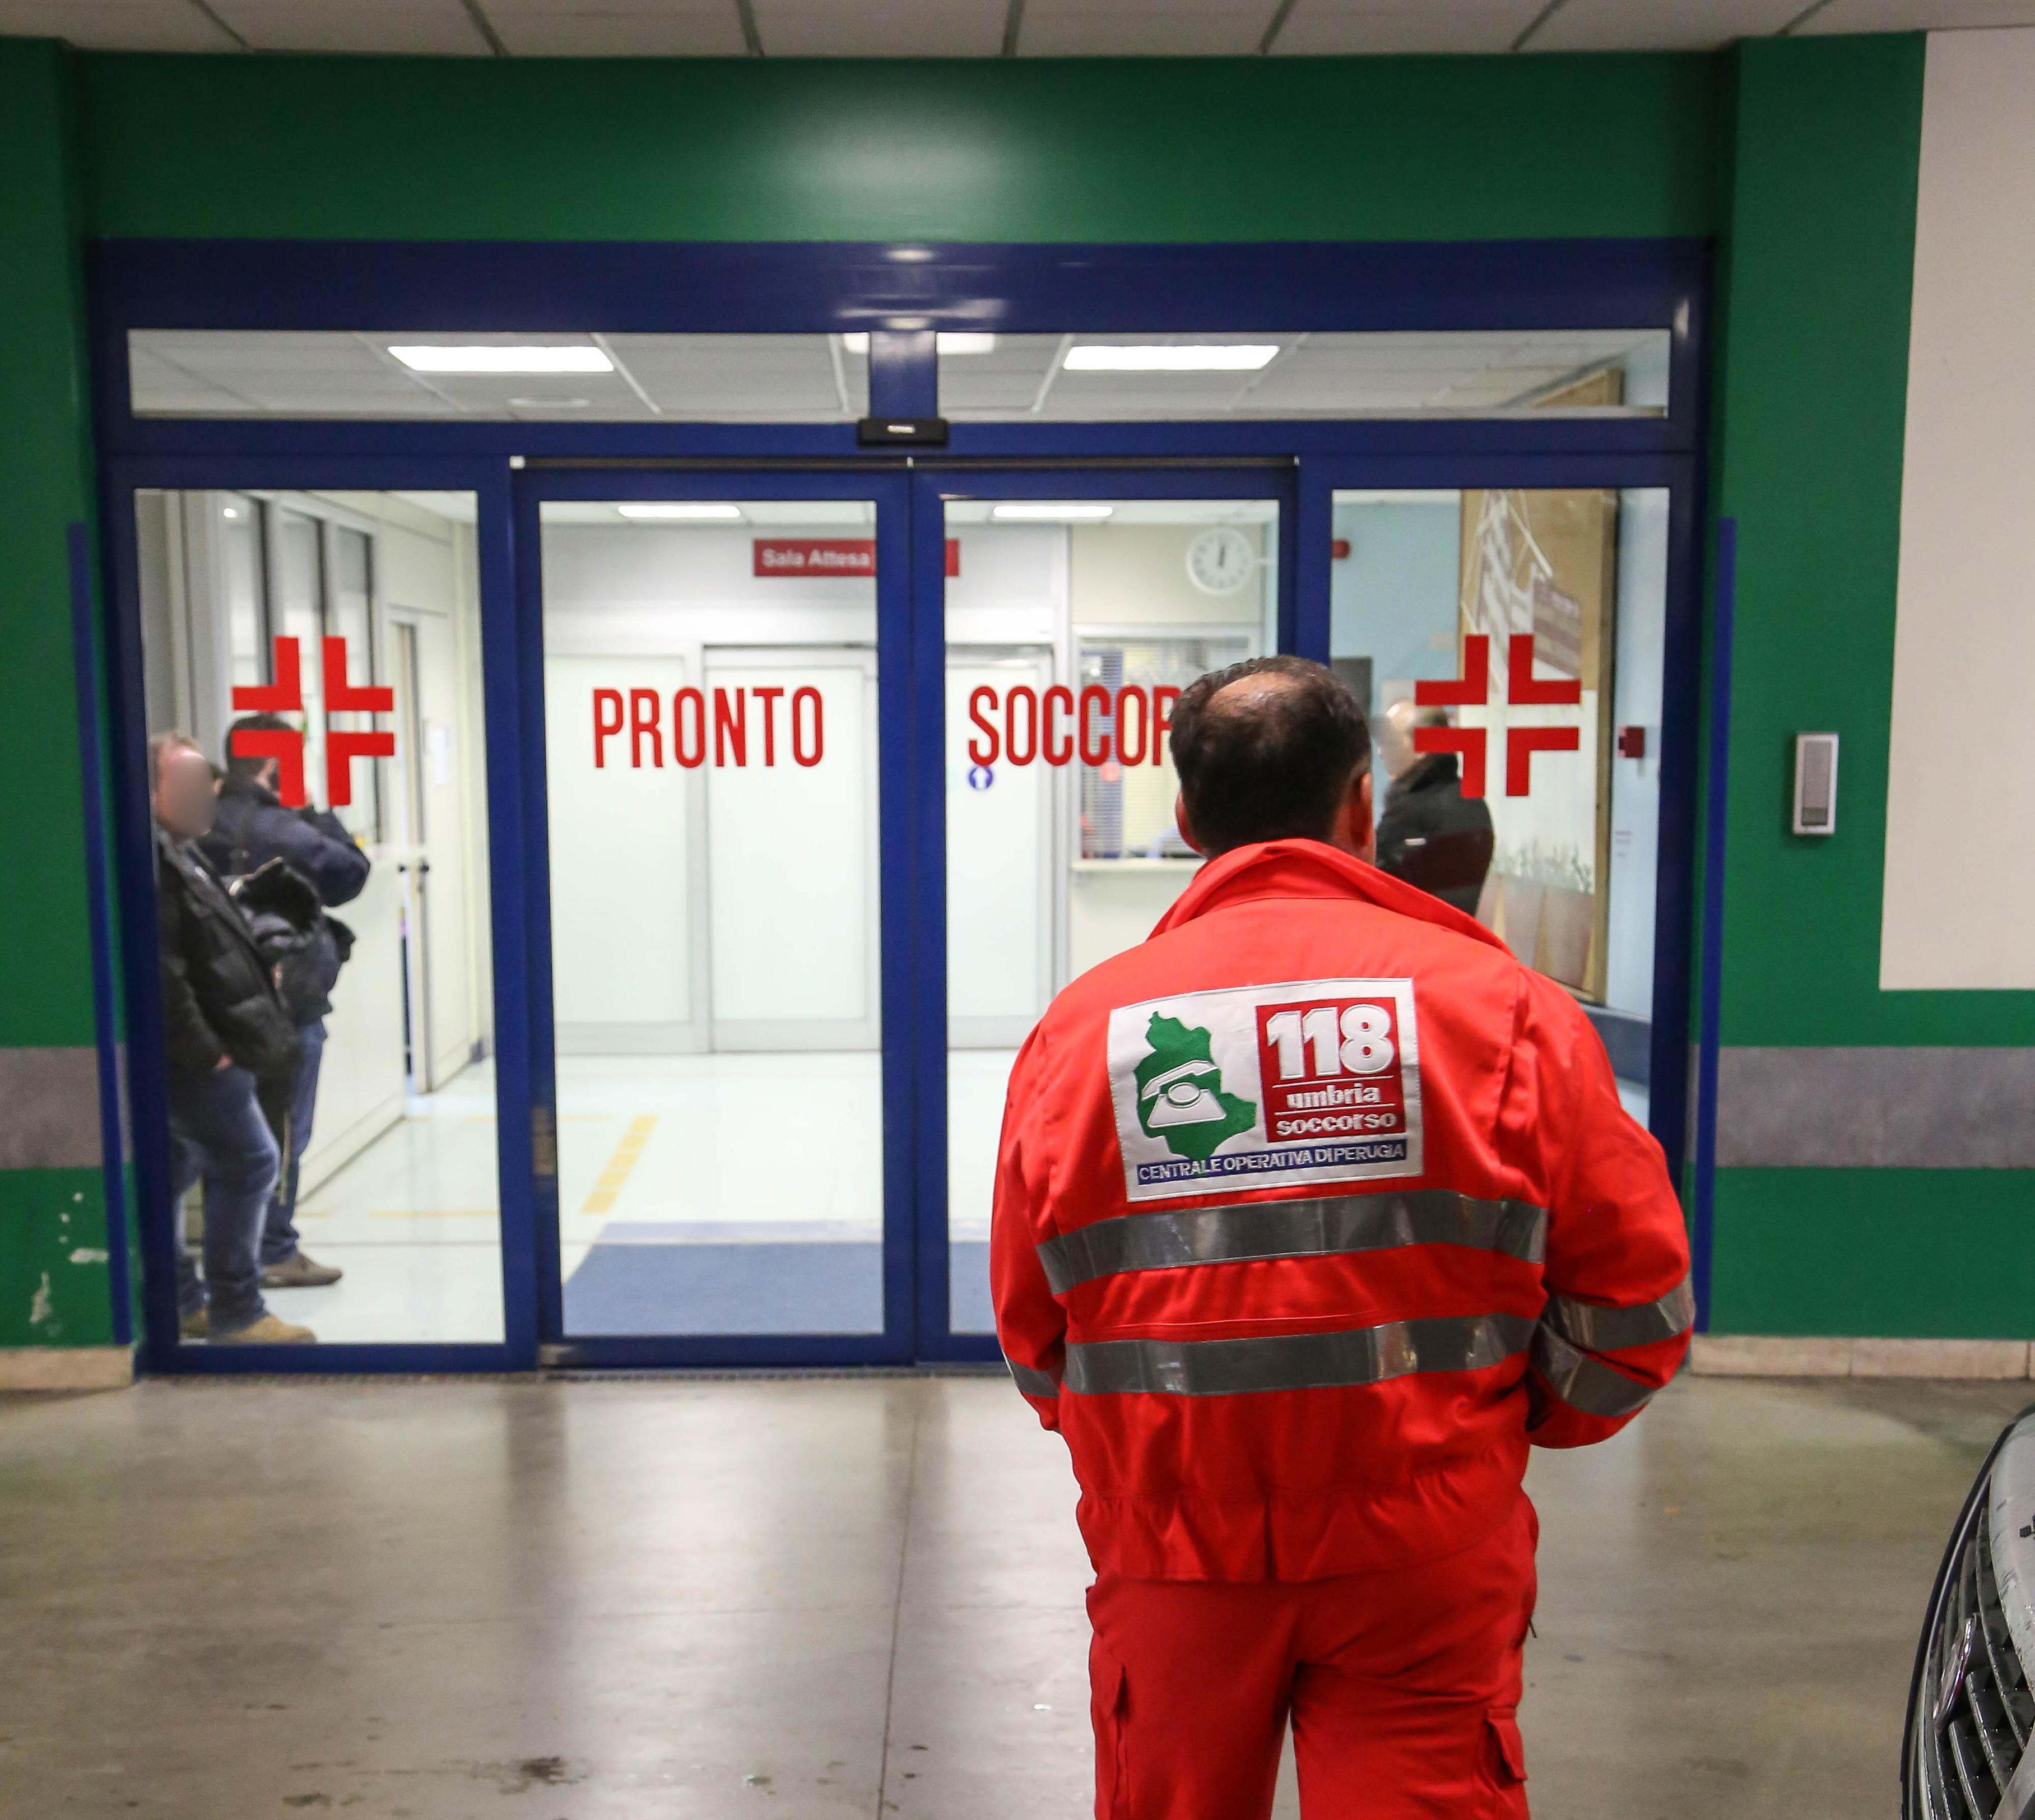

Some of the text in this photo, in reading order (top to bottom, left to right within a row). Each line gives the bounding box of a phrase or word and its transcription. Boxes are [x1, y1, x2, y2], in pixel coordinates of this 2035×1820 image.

[761, 548, 870, 568] Sala Attesa
[593, 686, 823, 768] PRONTO
[1266, 1004, 1395, 1080] 118
[1286, 1083, 1381, 1109] umbria
[1276, 1113, 1397, 1136] soccorso
[1139, 1158, 1221, 1180] CENTRALE
[1223, 1149, 1314, 1171] OPERATIVA
